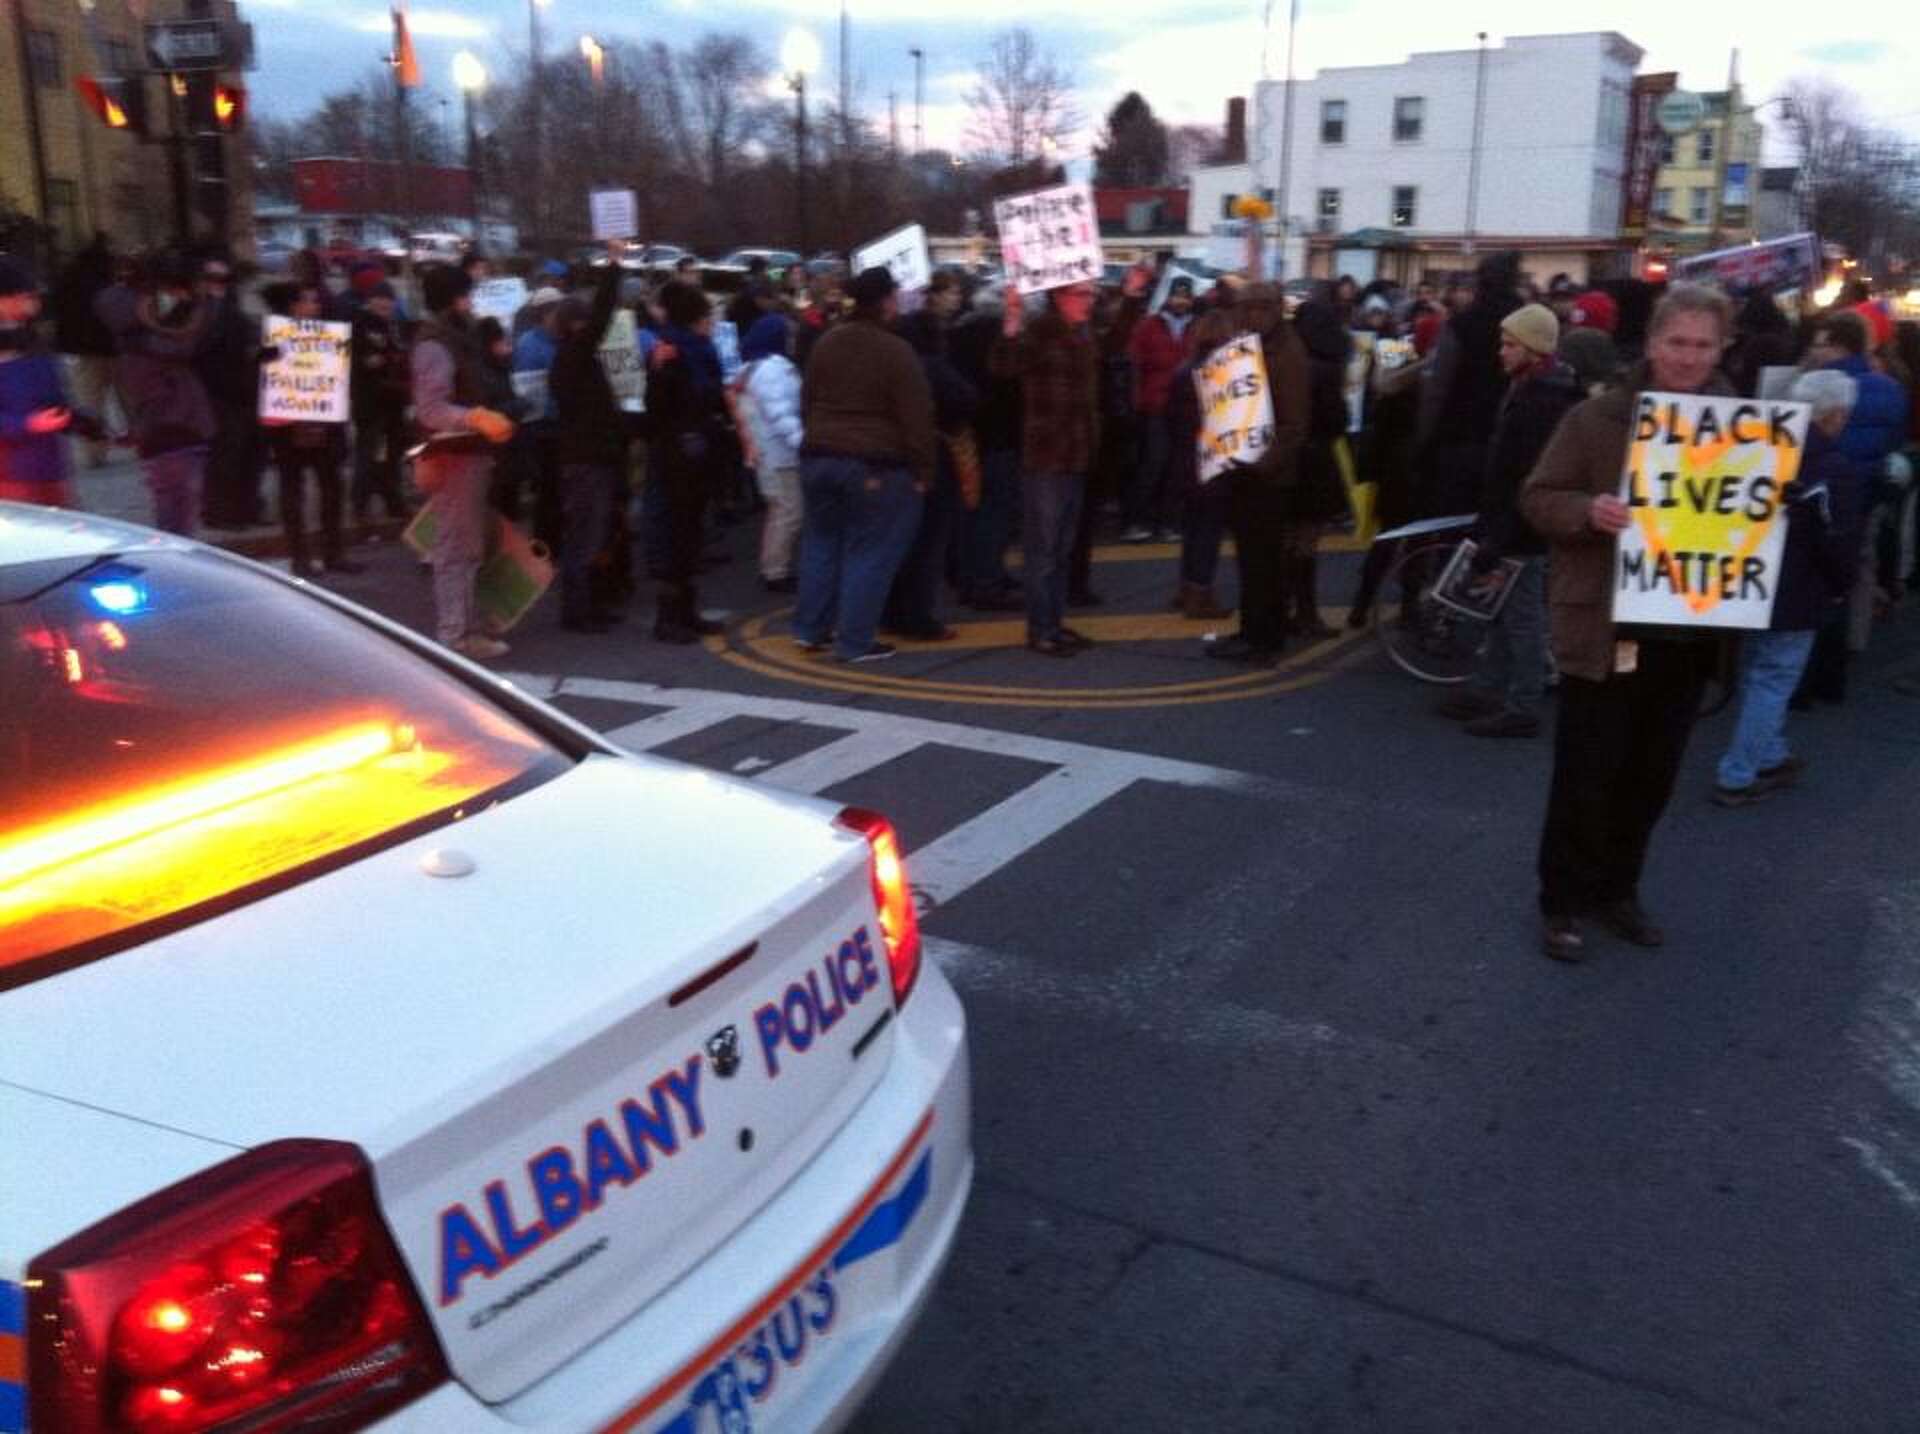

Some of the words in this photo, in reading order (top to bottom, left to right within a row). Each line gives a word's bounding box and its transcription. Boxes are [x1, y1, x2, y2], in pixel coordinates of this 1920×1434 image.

[1632, 396, 1797, 448] BLACK
[1628, 471, 1778, 523] LIVES
[1620, 548, 1769, 602] MATTER
[437, 1054, 706, 1308] ALBANY
[752, 925, 880, 1079] POLICE
